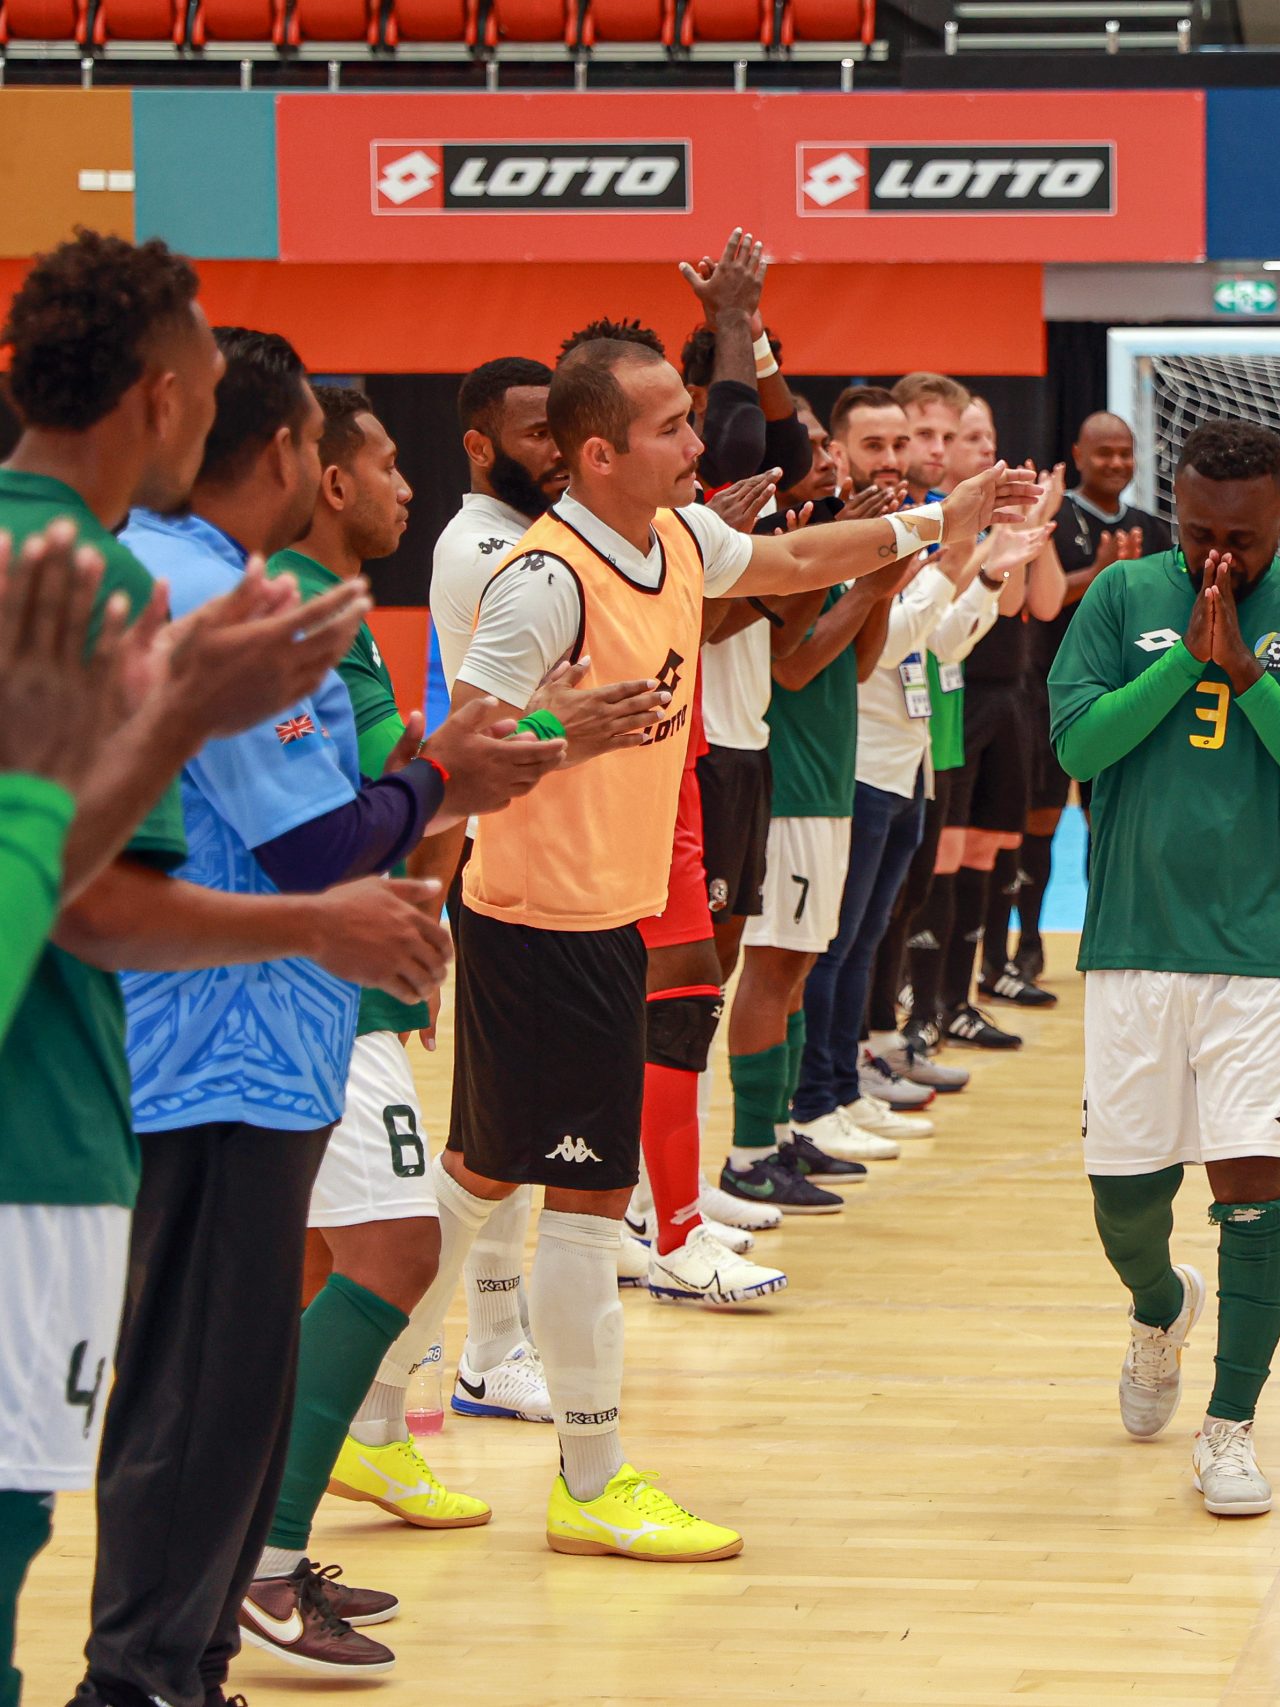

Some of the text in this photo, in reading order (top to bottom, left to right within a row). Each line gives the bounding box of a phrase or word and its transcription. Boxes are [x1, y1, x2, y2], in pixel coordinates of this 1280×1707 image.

[450, 156, 680, 197] LOTTO
[874, 158, 1105, 199] LOTTO
[639, 704, 688, 747] LOTTO
[1189, 681, 1230, 750] 3
[791, 874, 809, 926] 7
[476, 1275, 520, 1293] Kapp
[66, 1339, 106, 1440] 4
[565, 1407, 618, 1425] Kapp
